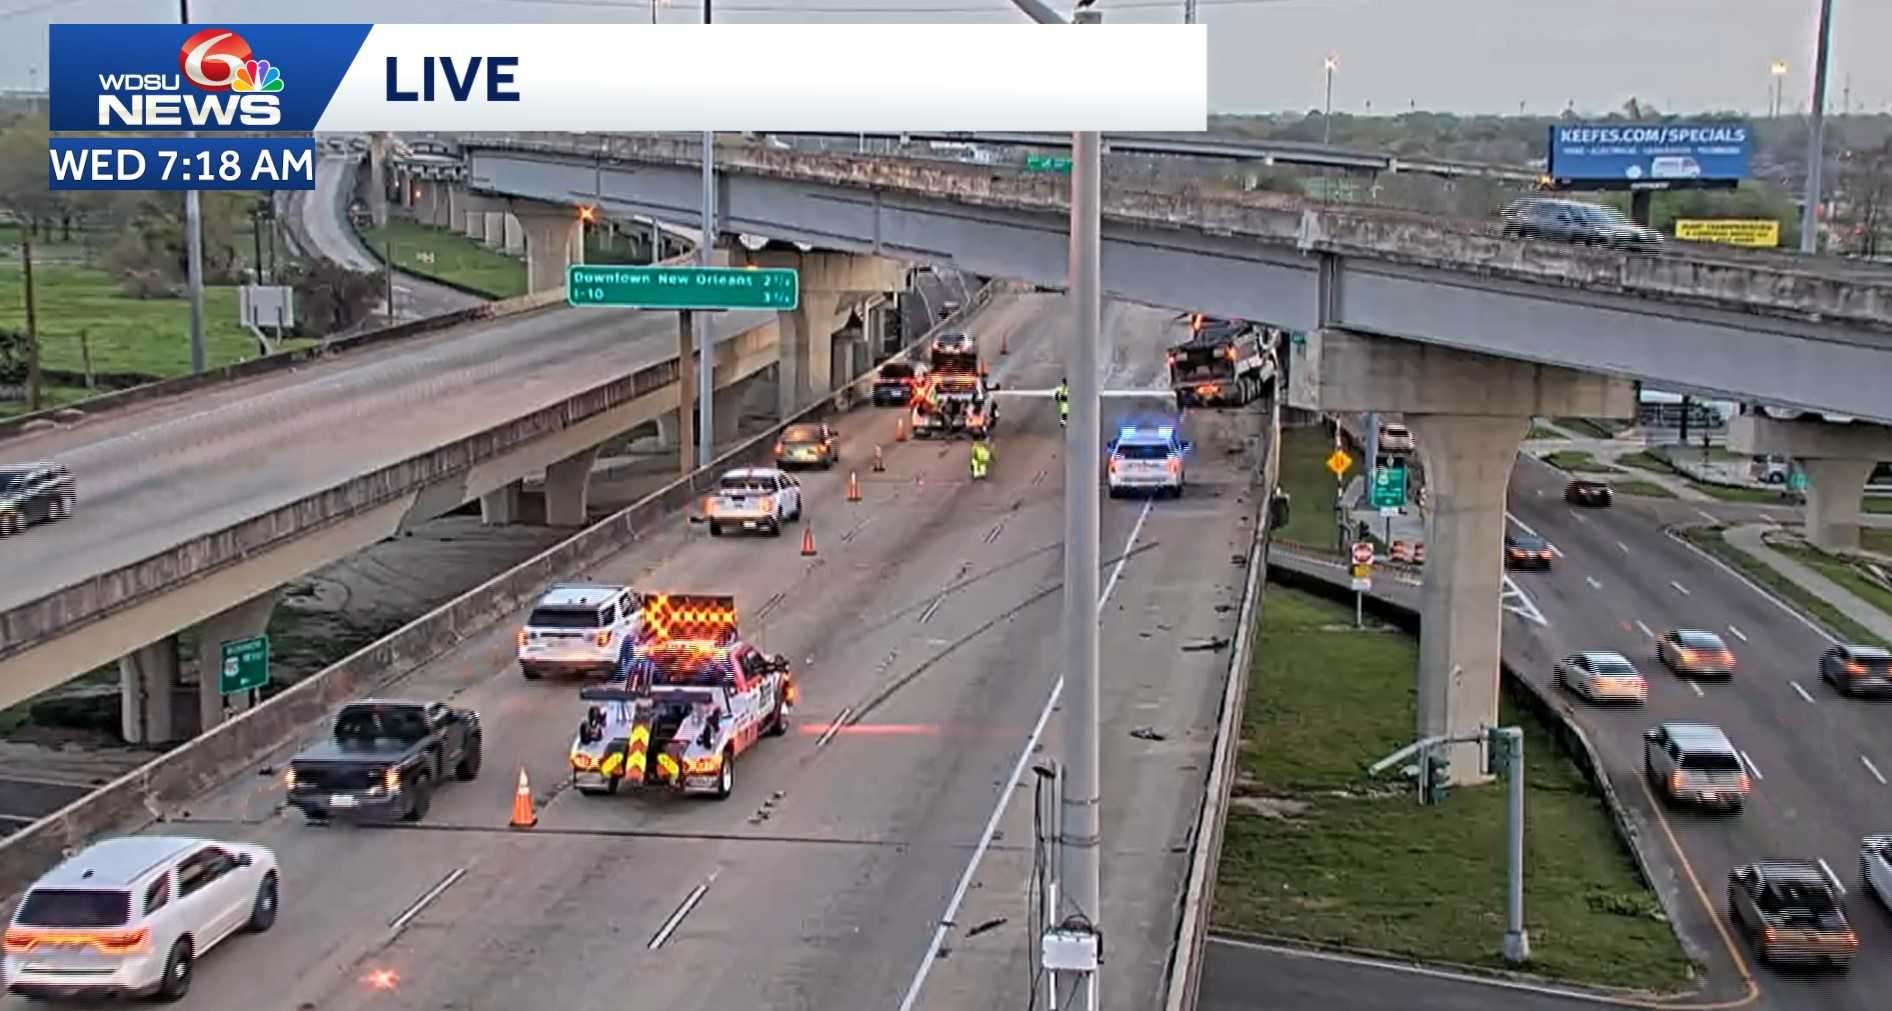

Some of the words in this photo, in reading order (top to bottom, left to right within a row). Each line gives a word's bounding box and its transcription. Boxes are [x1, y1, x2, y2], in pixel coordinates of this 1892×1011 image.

[1560, 127, 1746, 143] KEEFES.COM/SPECIALS
[574, 271, 650, 283] Downtown
[658, 274, 689, 285] New
[696, 274, 752, 286] Orleans
[574, 287, 604, 301] I-10
